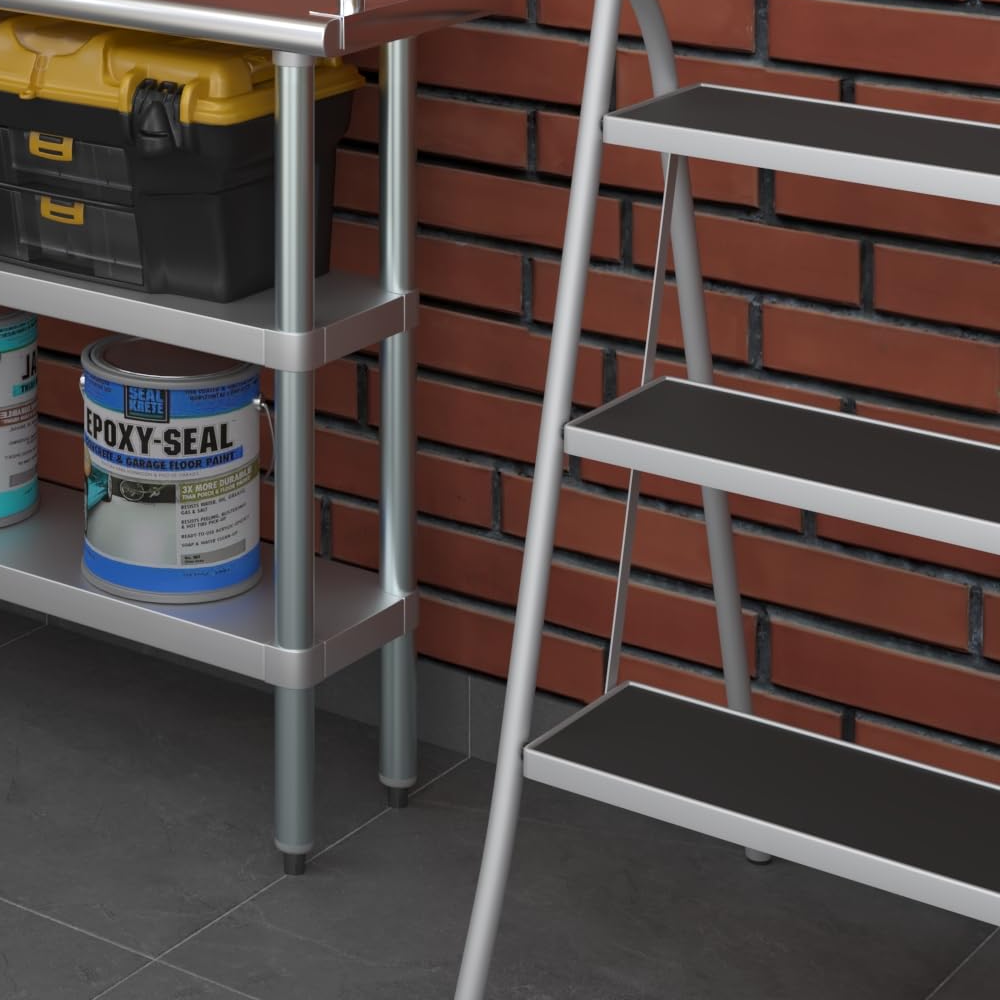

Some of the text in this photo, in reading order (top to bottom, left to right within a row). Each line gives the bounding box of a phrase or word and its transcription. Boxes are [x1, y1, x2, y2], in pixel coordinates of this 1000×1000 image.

[129, 387, 163, 401] SEAL
[129, 400, 163, 414] KRETE
[86, 408, 233, 455] EPOXY-SEAL
[116, 455, 123, 464] &
[126, 459, 168, 470] GARAGE
[170, 459, 201, 470] FLOOR
[207, 453, 236, 467] PAINT
[182, 468, 251, 494] 3X MORE DURABLE
[197, 491, 214, 499] PORCH
